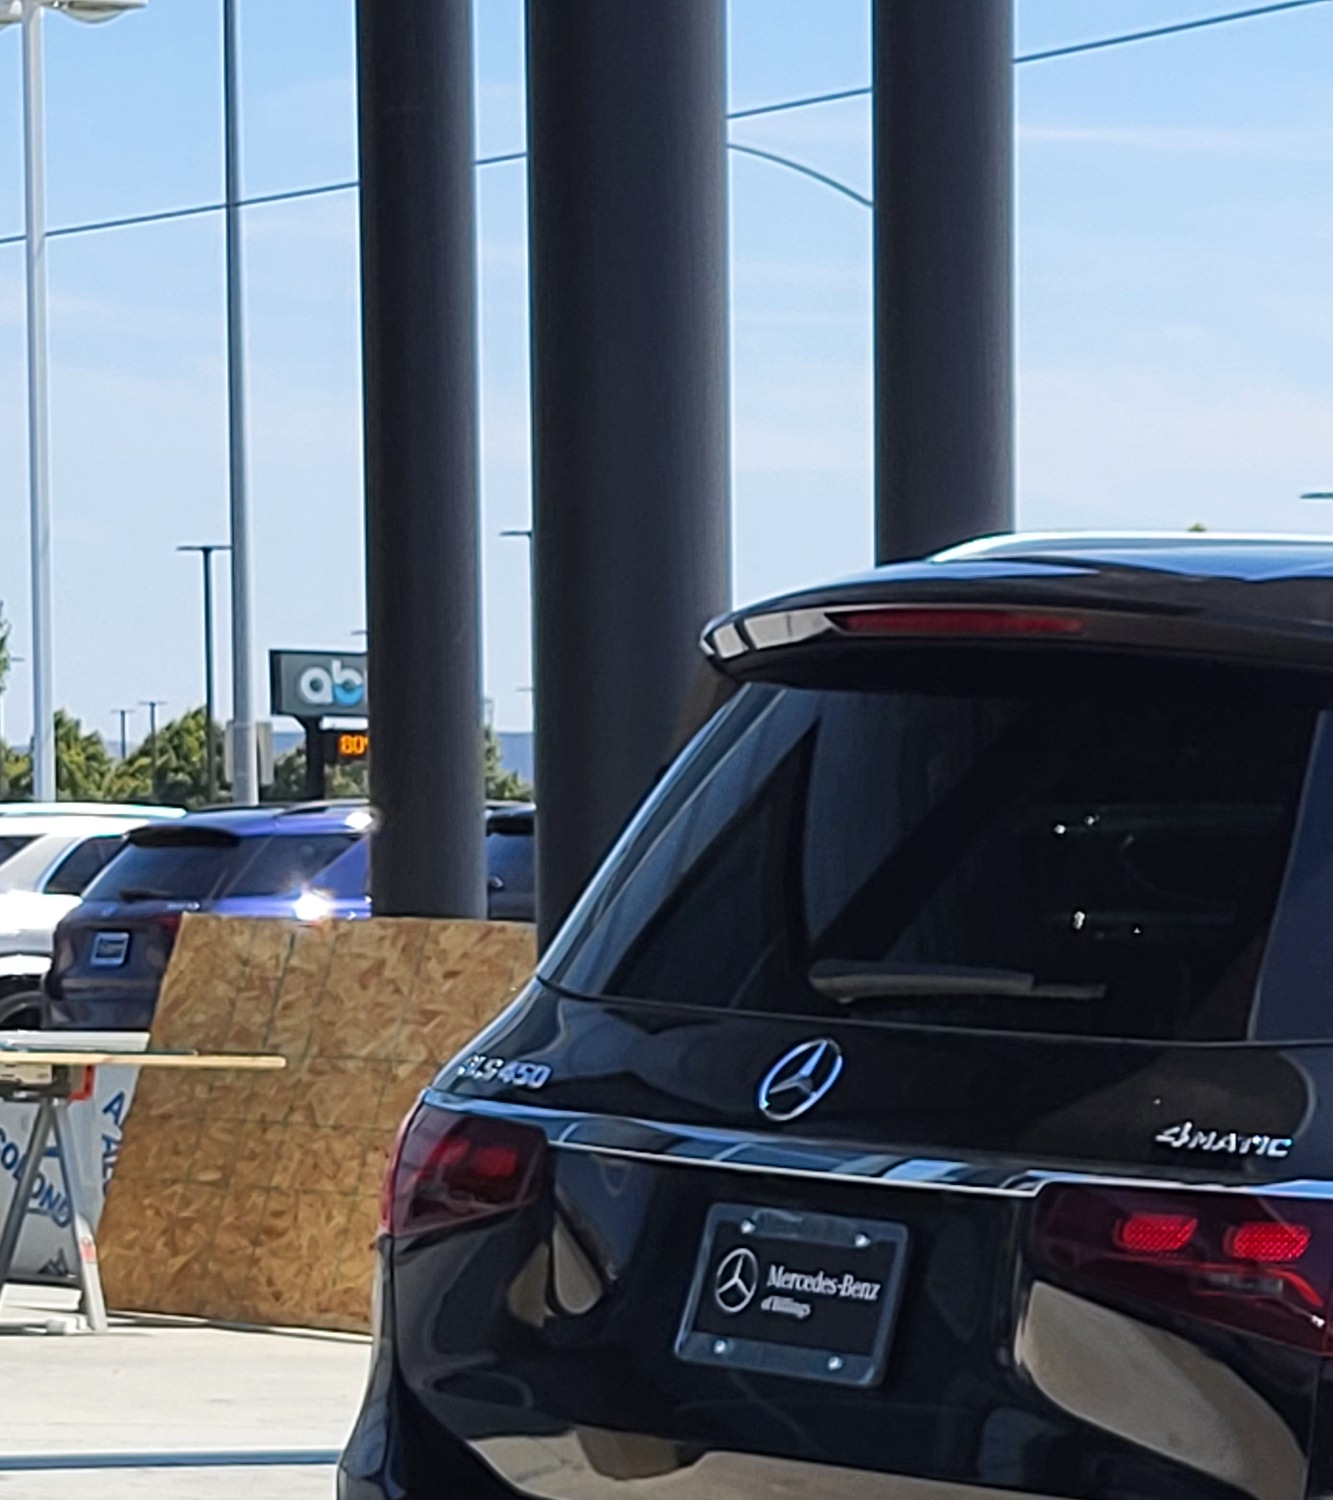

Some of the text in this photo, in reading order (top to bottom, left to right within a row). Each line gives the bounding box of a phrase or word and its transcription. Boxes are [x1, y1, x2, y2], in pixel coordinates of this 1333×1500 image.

[300, 659, 368, 707] ab
[1155, 1121, 1293, 1158] 4MATIC
[766, 1264, 881, 1301] Mercedes-Benz
